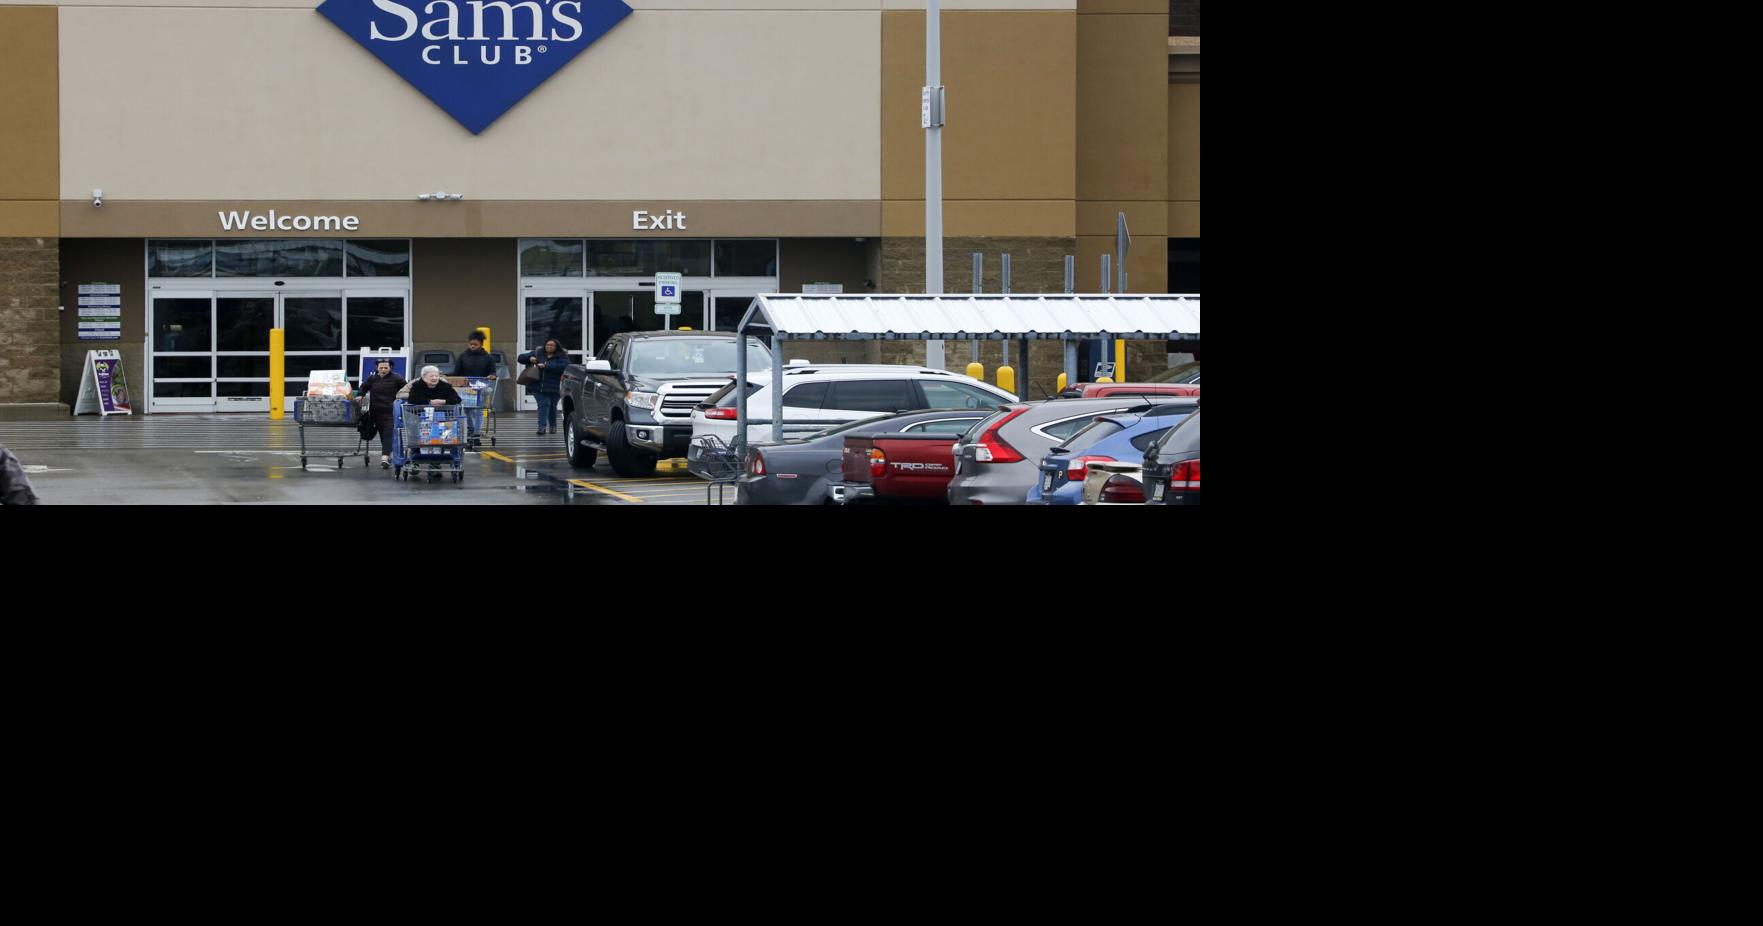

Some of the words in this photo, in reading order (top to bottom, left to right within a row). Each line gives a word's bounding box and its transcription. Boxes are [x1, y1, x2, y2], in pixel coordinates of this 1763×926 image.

[218, 209, 360, 231] Welcome
[633, 209, 687, 230] Exit
[890, 462, 924, 471] TRD
